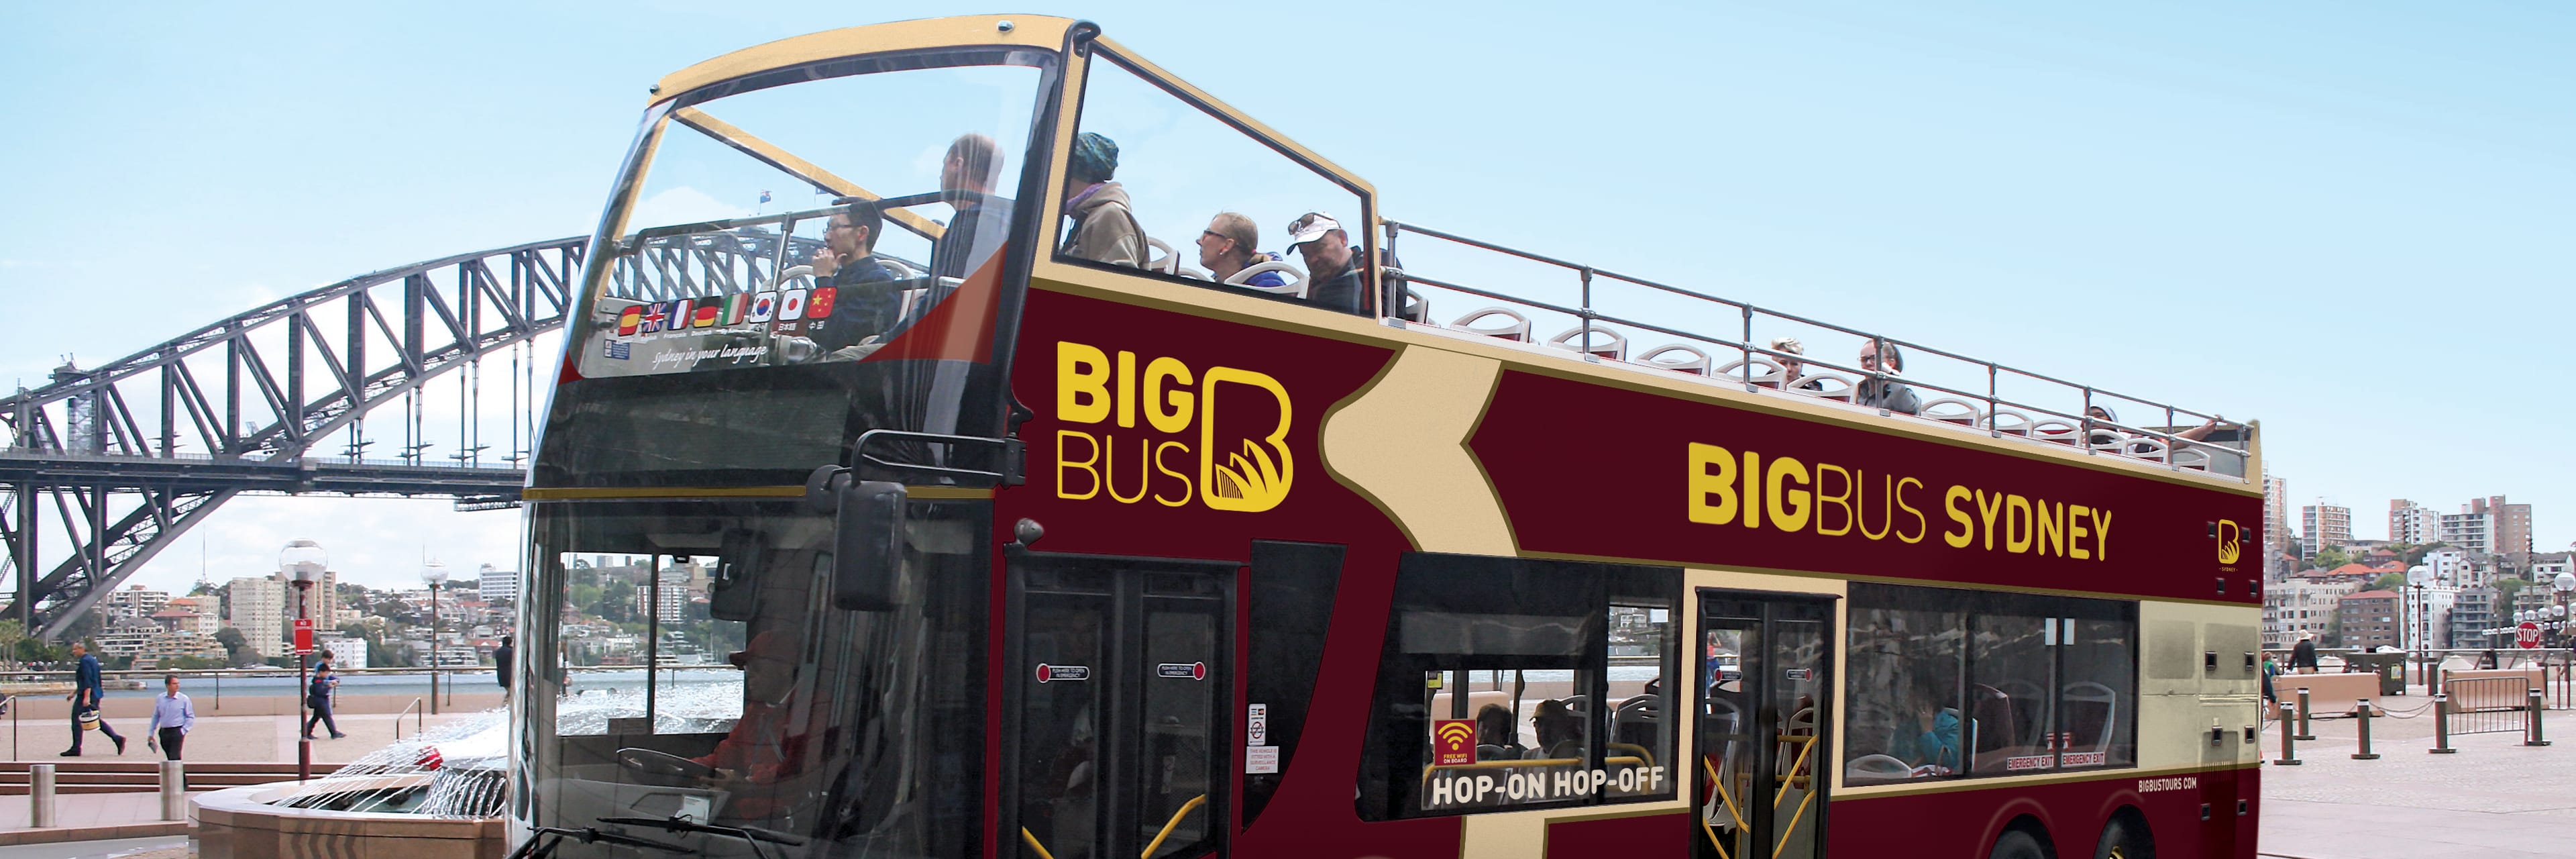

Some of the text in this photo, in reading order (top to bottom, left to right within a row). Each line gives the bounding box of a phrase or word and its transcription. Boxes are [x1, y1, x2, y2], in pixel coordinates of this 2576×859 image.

[652, 348, 685, 370] Sydney
[686, 347, 696, 360] in
[692, 348, 720, 368] your
[720, 344, 768, 364] language
[1057, 341, 1194, 434] BIG
[1057, 430, 1193, 507] BUS
[1944, 485, 2112, 561] SYDNEY
[2516, 627, 2539, 643] STOP
[2008, 756, 2053, 768] EMERGENCY EXIT
[2063, 753, 2104, 765] EMERGENCY EXIT
[1433, 766, 1664, 805] HOP-ON HOP-OFF
